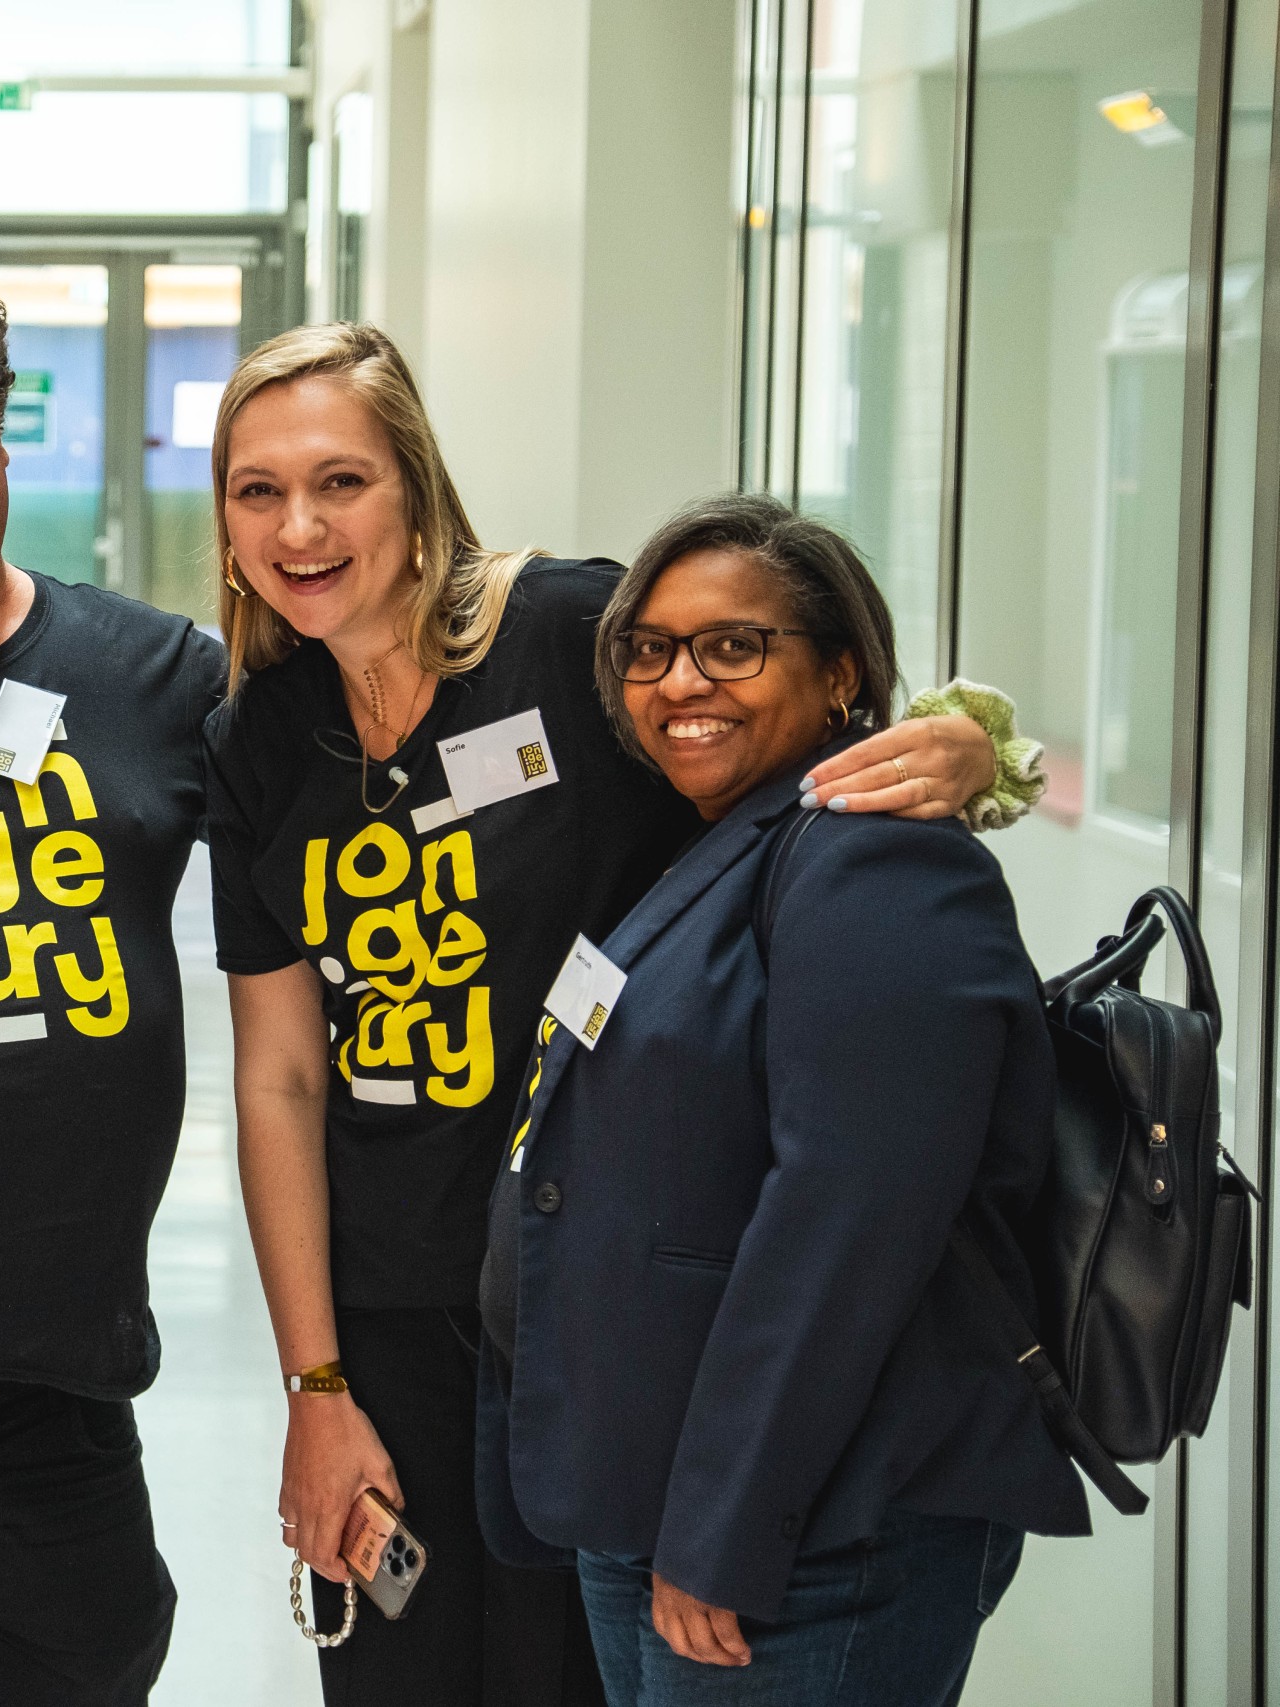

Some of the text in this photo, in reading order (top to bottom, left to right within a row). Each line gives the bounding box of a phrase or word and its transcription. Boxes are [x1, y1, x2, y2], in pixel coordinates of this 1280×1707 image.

[445, 743, 466, 754] Sofie
[522, 745, 541, 758] jon
[528, 761, 546, 776] jury
[302, 822, 478, 946] jon
[347, 900, 487, 1002] ge
